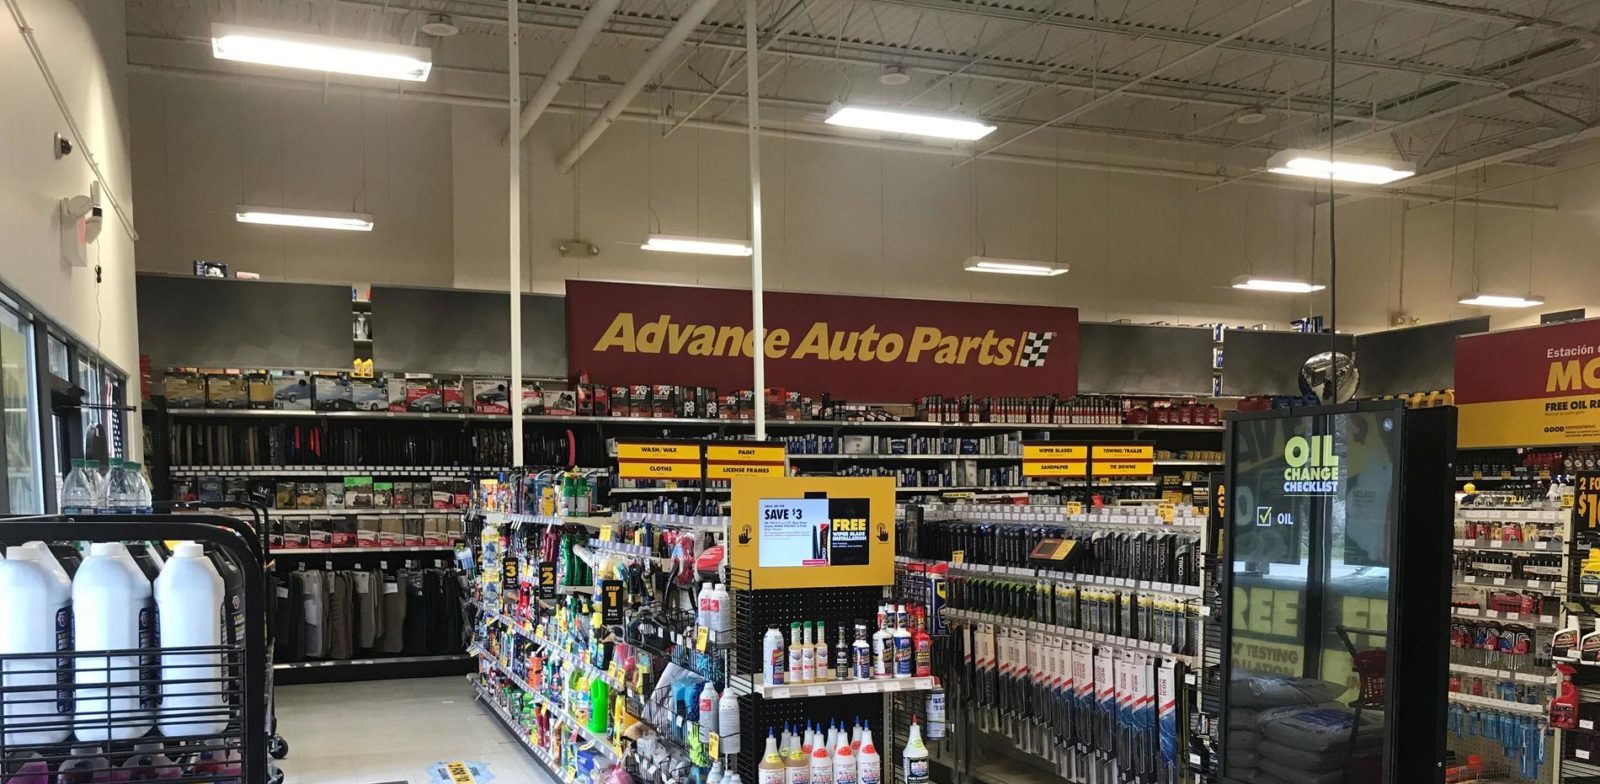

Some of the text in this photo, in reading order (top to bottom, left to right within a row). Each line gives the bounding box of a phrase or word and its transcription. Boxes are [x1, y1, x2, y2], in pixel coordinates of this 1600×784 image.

[593, 312, 1016, 366] Advance Auto Parts
[1547, 345, 1594, 358] Estación
[1545, 402, 1568, 411] FREE
[1570, 400, 1587, 410] OIL
[1284, 435, 1339, 468] OIL
[1283, 467, 1339, 481] CHANGE
[1283, 481, 1339, 493] CHECKLIST
[1579, 477, 1586, 490] 2
[764, 507, 803, 520] SAVE $3
[1277, 513, 1294, 525] OIL
[832, 518, 867, 531] FREE
[506, 565, 516, 577] 3
[541, 571, 554, 585] 2
[608, 591, 617, 607] 1
[1247, 644, 1299, 665] TESTING
